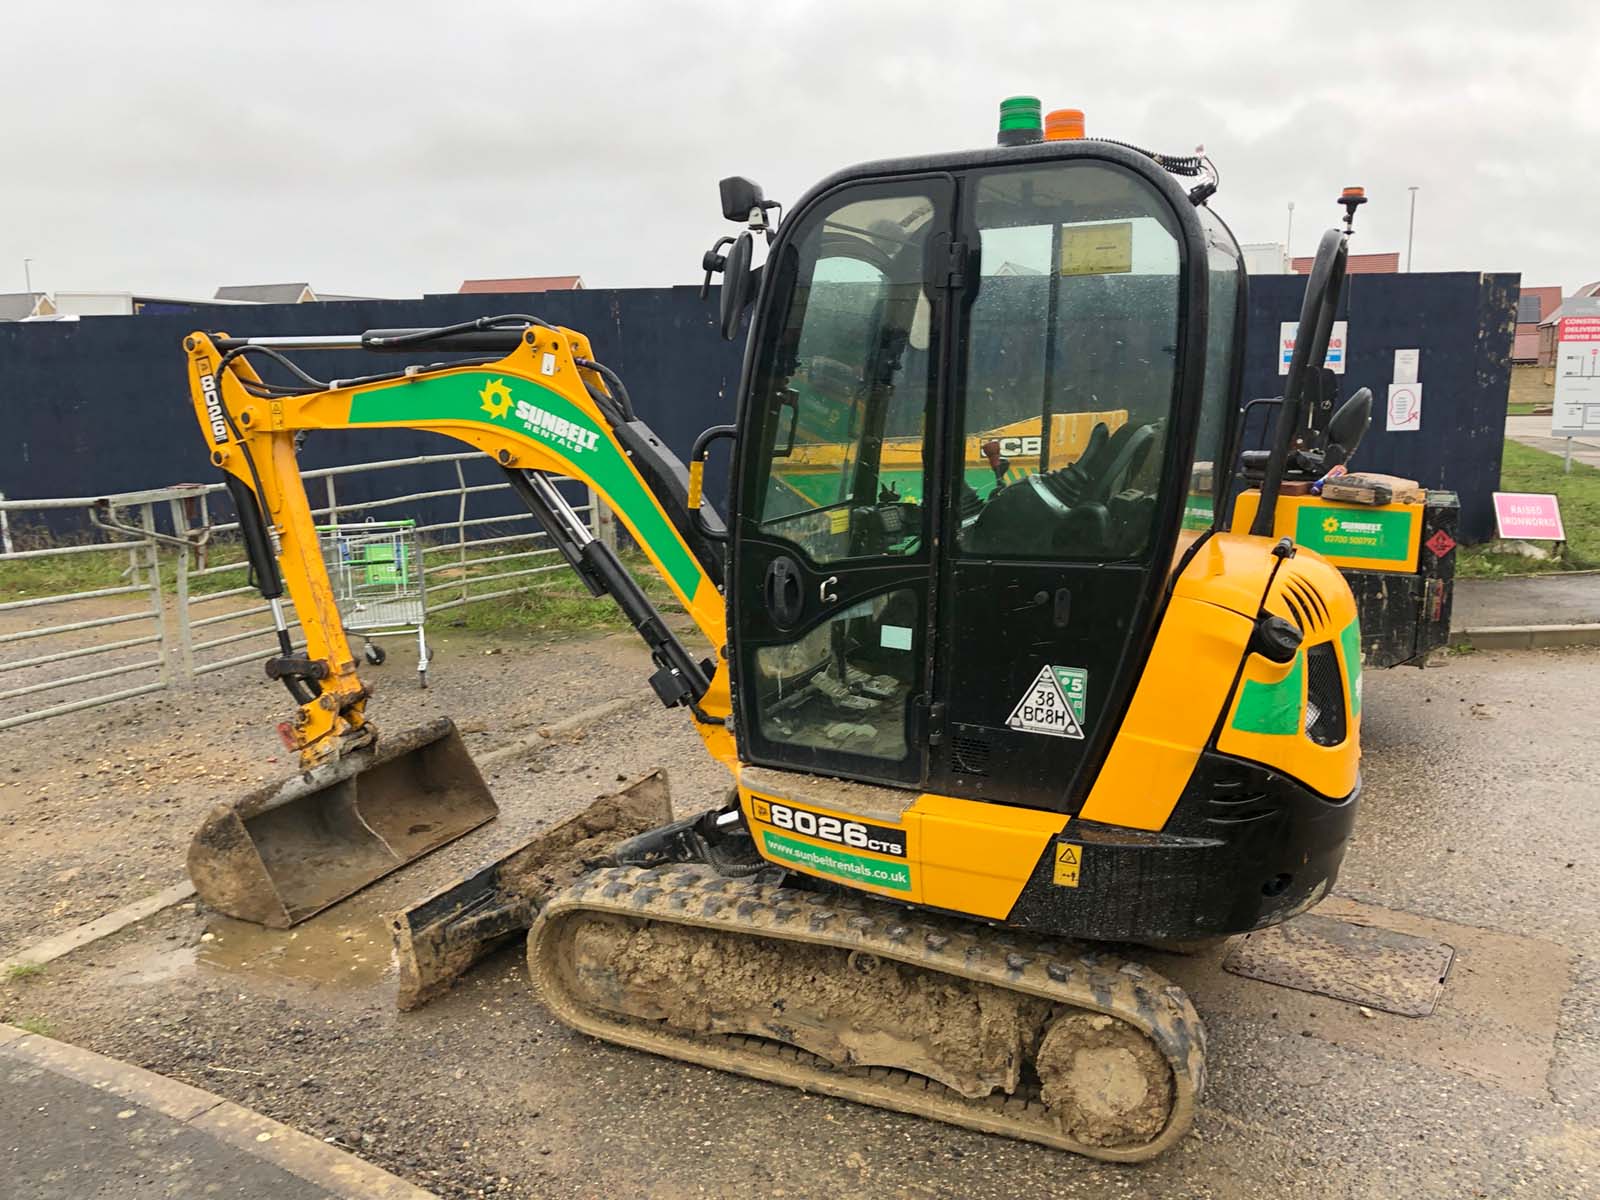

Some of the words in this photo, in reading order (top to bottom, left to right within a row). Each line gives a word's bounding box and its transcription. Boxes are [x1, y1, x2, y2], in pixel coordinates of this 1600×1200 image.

[515, 400, 599, 450] SUNBELT
[523, 421, 582, 453] RENTALS
[1510, 504, 1543, 515] RAISED
[1502, 517, 1556, 527] IRONWORKS
[1035, 690, 1055, 708] 38
[1024, 706, 1066, 726] BC8H
[767, 840, 907, 883] www.sunbeltrentals.co.uk
